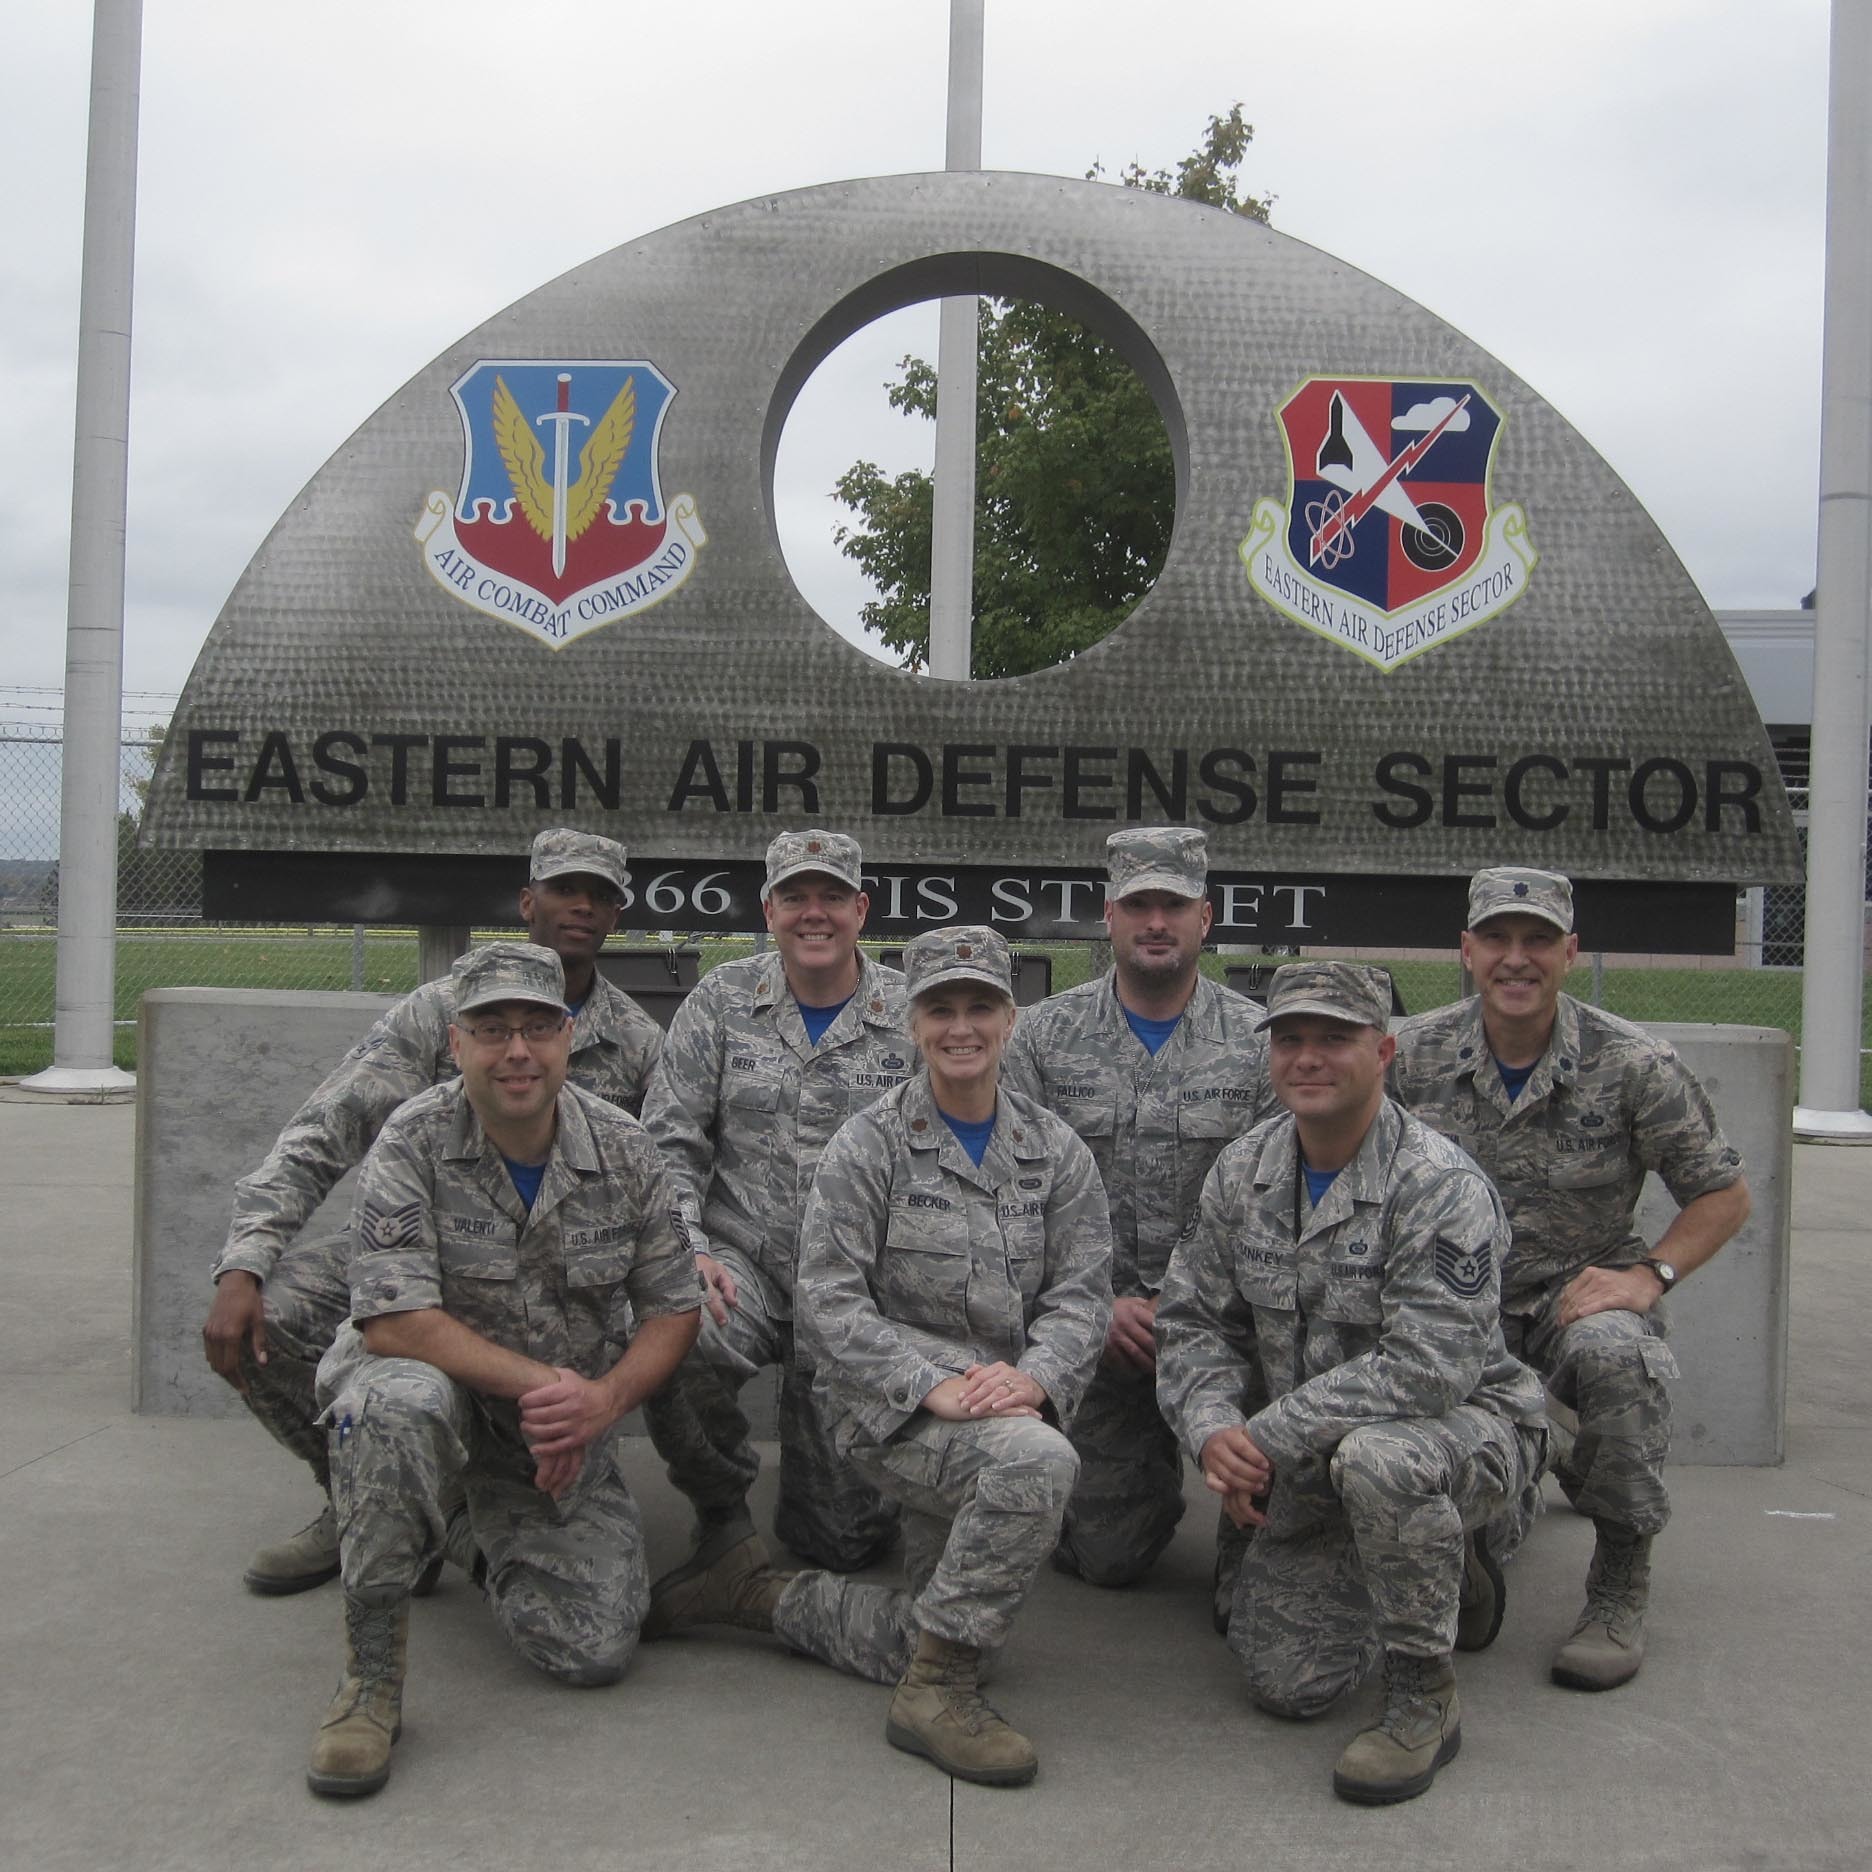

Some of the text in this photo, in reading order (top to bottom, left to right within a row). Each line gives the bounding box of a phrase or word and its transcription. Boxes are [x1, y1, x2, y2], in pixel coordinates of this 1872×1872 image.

[434, 542, 686, 638] AIR COMBAT COMMAND
[1264, 554, 1513, 661] EASTERN AIR DEFENSE SECTOR
[187, 729, 1763, 835] EASTERN AIR DEFENSE SECTOR
[991, 878, 1326, 928] STET
[876, 1074, 893, 1088] AIR
[1204, 1088, 1220, 1101] AIR
[1222, 1088, 1251, 1101] FORCE
[908, 1194, 951, 1211] BECKER
[1023, 1203, 1039, 1216] AIR
[594, 1228, 609, 1244] AIR
[1229, 1239, 1284, 1266] NKEY
